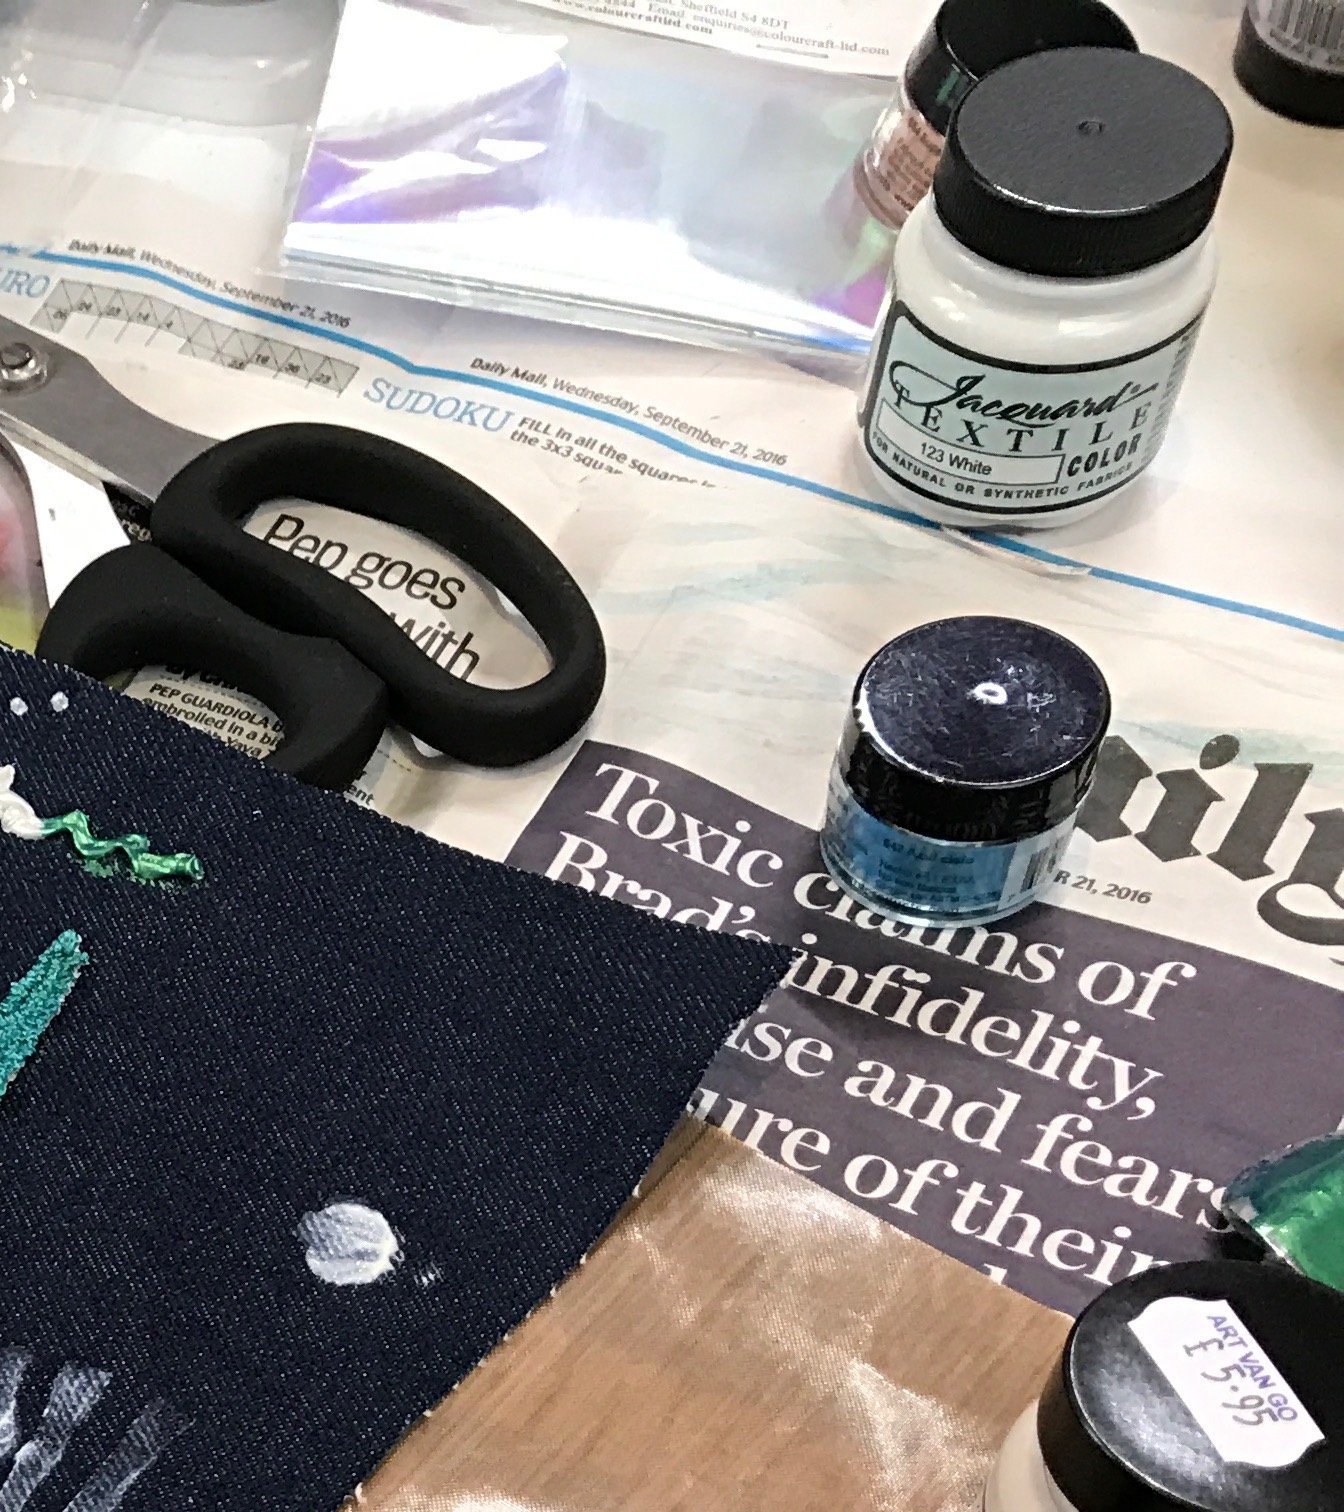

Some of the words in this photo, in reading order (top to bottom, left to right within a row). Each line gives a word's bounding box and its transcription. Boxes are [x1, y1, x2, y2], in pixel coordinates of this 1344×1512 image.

[363, 376, 516, 433] SUDOKU
[469, 356, 509, 376] Daily
[510, 366, 549, 388] Mail,
[552, 376, 641, 417] Wednesday,
[643, 405, 730, 450] September
[752, 448, 789, 467] 2016
[892, 378, 1153, 453] TEXTILE
[509, 429, 541, 449] the
[540, 438, 573, 460] 3x3
[517, 416, 553, 437] FILL
[574, 434, 598, 451] all
[599, 439, 628, 465] the
[920, 441, 946, 464] 123
[948, 450, 994, 478] White
[1066, 432, 1143, 478] COLOR
[892, 451, 947, 489] NATURAL
[954, 481, 976, 496] OR
[983, 484, 1070, 500] SYNTHETIC
[1076, 460, 1134, 492] FABRICS
[344, 551, 466, 610] goes
[149, 682, 181, 699] PEP
[181, 692, 269, 731] GUARDIOLA
[227, 722, 245, 740] in
[245, 730, 258, 742] a
[261, 731, 281, 749] bi
[585, 763, 783, 888] Toxic
[1078, 960, 1197, 1021] of
[1071, 875, 1098, 894] 21,
[1101, 881, 1153, 904] 2016
[782, 933, 1163, 1120] infidelity,
[843, 1059, 1022, 1153] and
[843, 1153, 959, 1216] of
[1207, 1315, 1249, 1349] ART
[1238, 1350, 1277, 1390] VAN
[1267, 1392, 1298, 1422] GO
